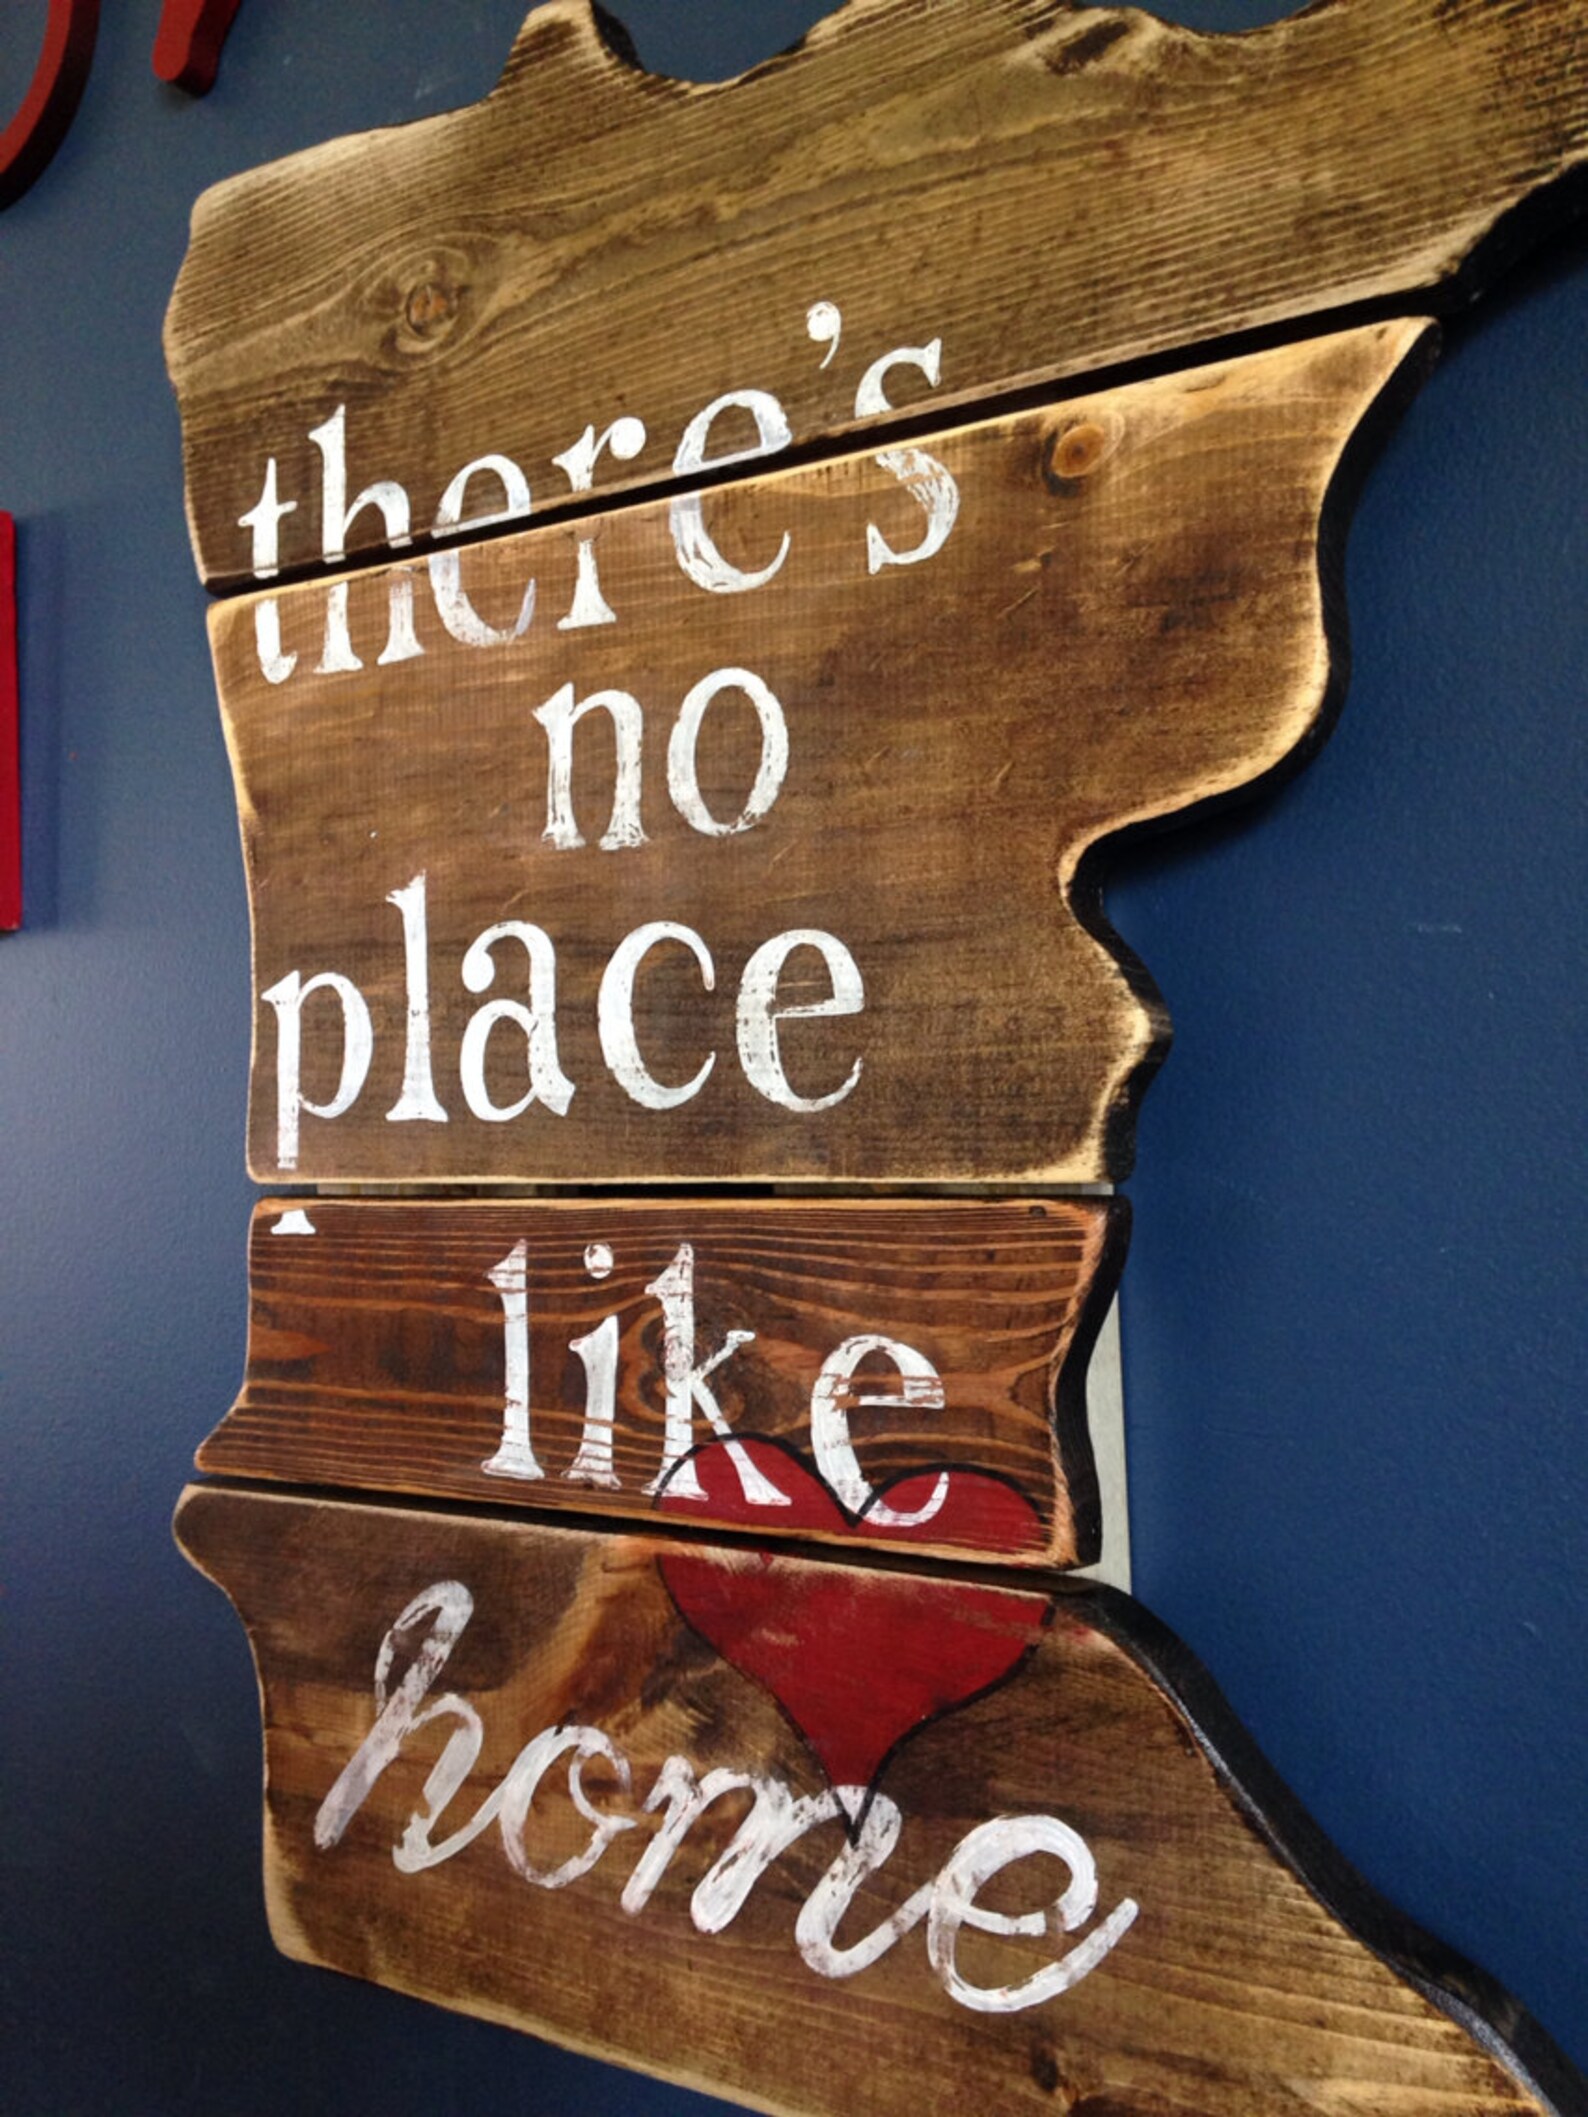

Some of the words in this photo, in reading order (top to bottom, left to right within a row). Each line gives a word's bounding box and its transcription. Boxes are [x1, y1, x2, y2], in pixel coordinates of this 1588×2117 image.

[237, 302, 961, 687] there's
[533, 667, 789, 852] no
[261, 870, 865, 1236] place
[481, 1239, 948, 1528] like
[314, 1581, 1138, 2012] home
